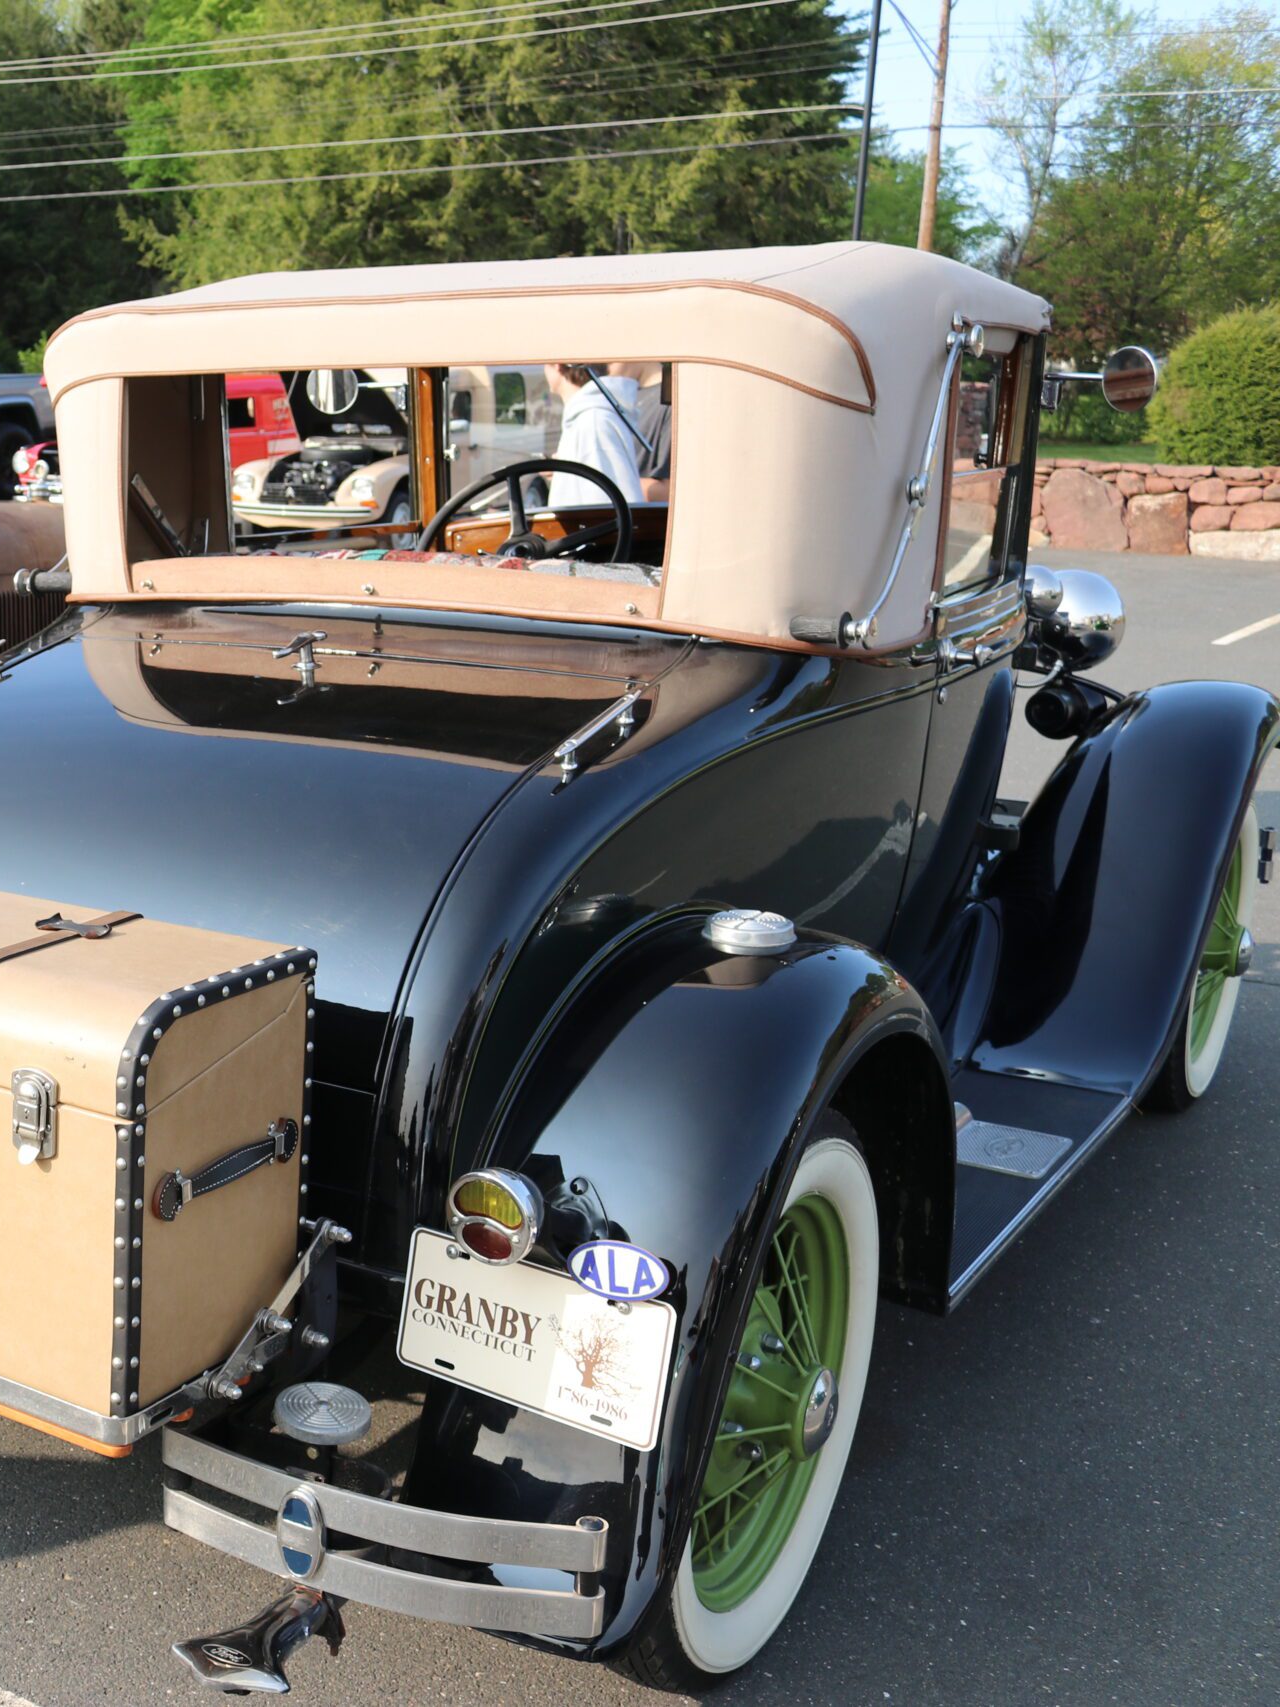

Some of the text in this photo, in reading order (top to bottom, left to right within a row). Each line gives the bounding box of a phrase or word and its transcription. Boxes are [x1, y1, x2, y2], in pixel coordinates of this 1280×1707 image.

[579, 1248, 657, 1295] ALA
[411, 1307, 537, 1362] CONNECTICUT
[414, 1278, 542, 1346] GRANBY
[558, 1385, 628, 1421] 1786-1986
